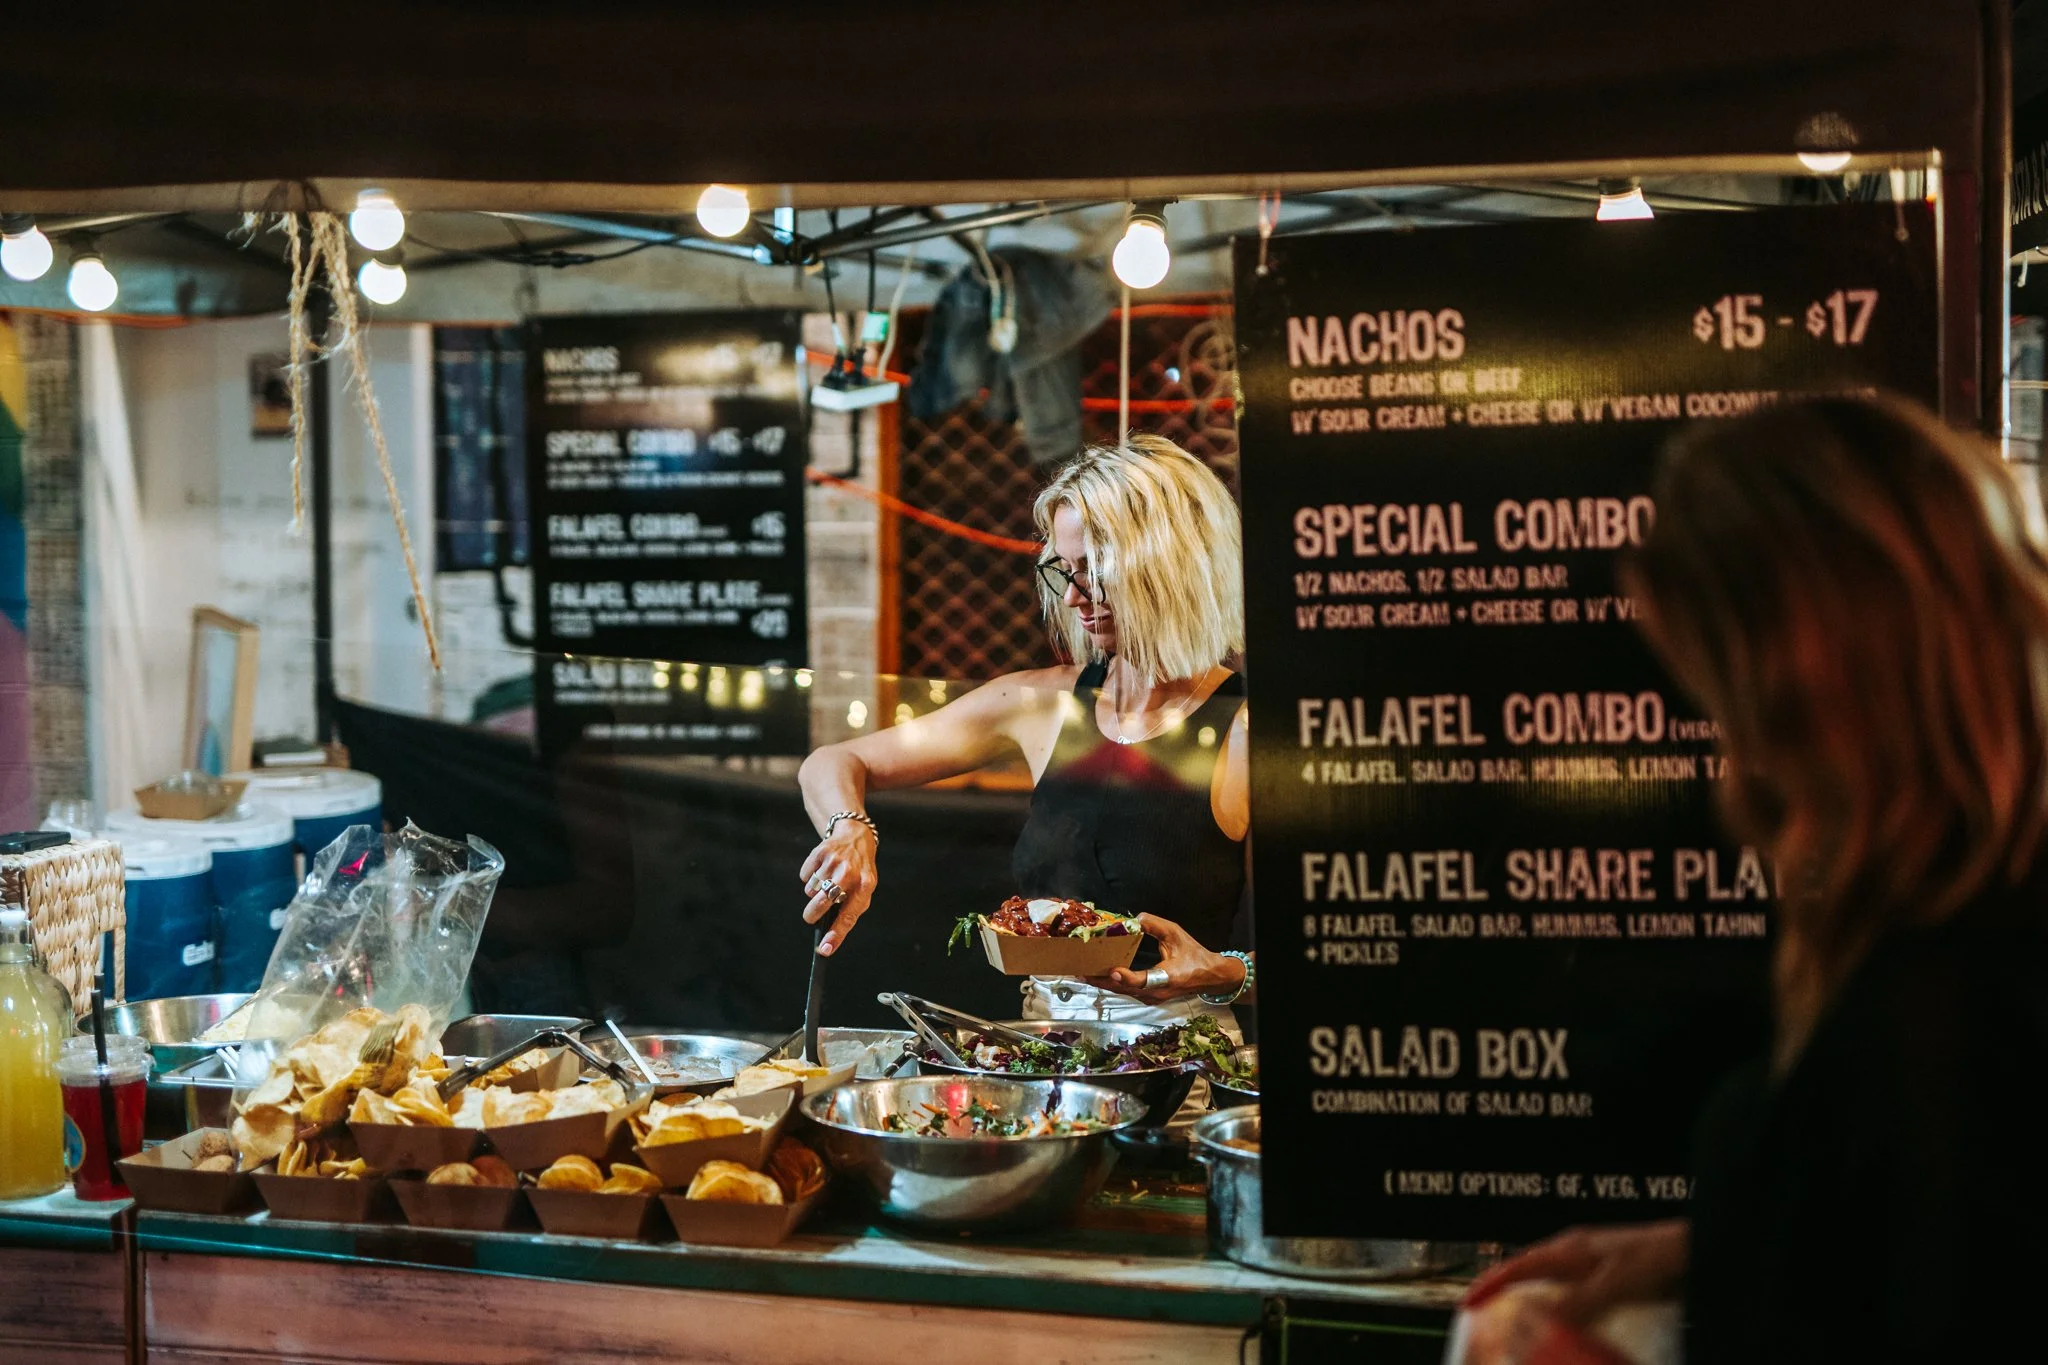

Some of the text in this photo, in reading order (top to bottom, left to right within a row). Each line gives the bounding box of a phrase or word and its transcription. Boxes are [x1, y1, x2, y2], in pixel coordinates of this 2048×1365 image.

[1287, 308, 1465, 367] NACHOS
[1693, 294, 1766, 350] $15
[1805, 287, 1879, 345] $17
[1289, 375, 1363, 400] CHOOSE
[1369, 372, 1435, 398] BEANS
[1440, 370, 1468, 394] OR
[1376, 405, 1446, 430] CREAM
[1467, 400, 1540, 427] CHEESE
[1547, 398, 1576, 423] OR
[1294, 495, 1656, 557] SPECIAL COMBO
[1295, 573, 1323, 598] 1/2
[1417, 568, 1446, 594] 1/2
[1452, 567, 1520, 592] SALAD
[1525, 564, 1569, 590] BAR
[1380, 602, 1450, 629] CREAM
[1471, 599, 1546, 626] CHEESE
[1550, 599, 1579, 623] OR
[1299, 696, 1486, 748] FALAFEL
[1503, 691, 1666, 746] COMBO
[1301, 763, 1315, 785] 4
[1411, 759, 1476, 784] SALAD
[1628, 756, 1696, 780] LEMON
[1302, 852, 1489, 901] FALAFEL
[1506, 848, 1656, 901] SHARE
[1303, 915, 1317, 938] 8
[1410, 914, 1475, 938] SALAD
[1627, 913, 1695, 937] LEMON
[1702, 914, 1766, 938] TAHINI
[1322, 942, 1400, 965] PICKLES
[1309, 1026, 1570, 1080] SALAD BOX
[1312, 1091, 1592, 1117] COMBINATION OF SALAD BAR
[1399, 1171, 1454, 1195] MENU
[1460, 1172, 1550, 1197] OPTIONS:
